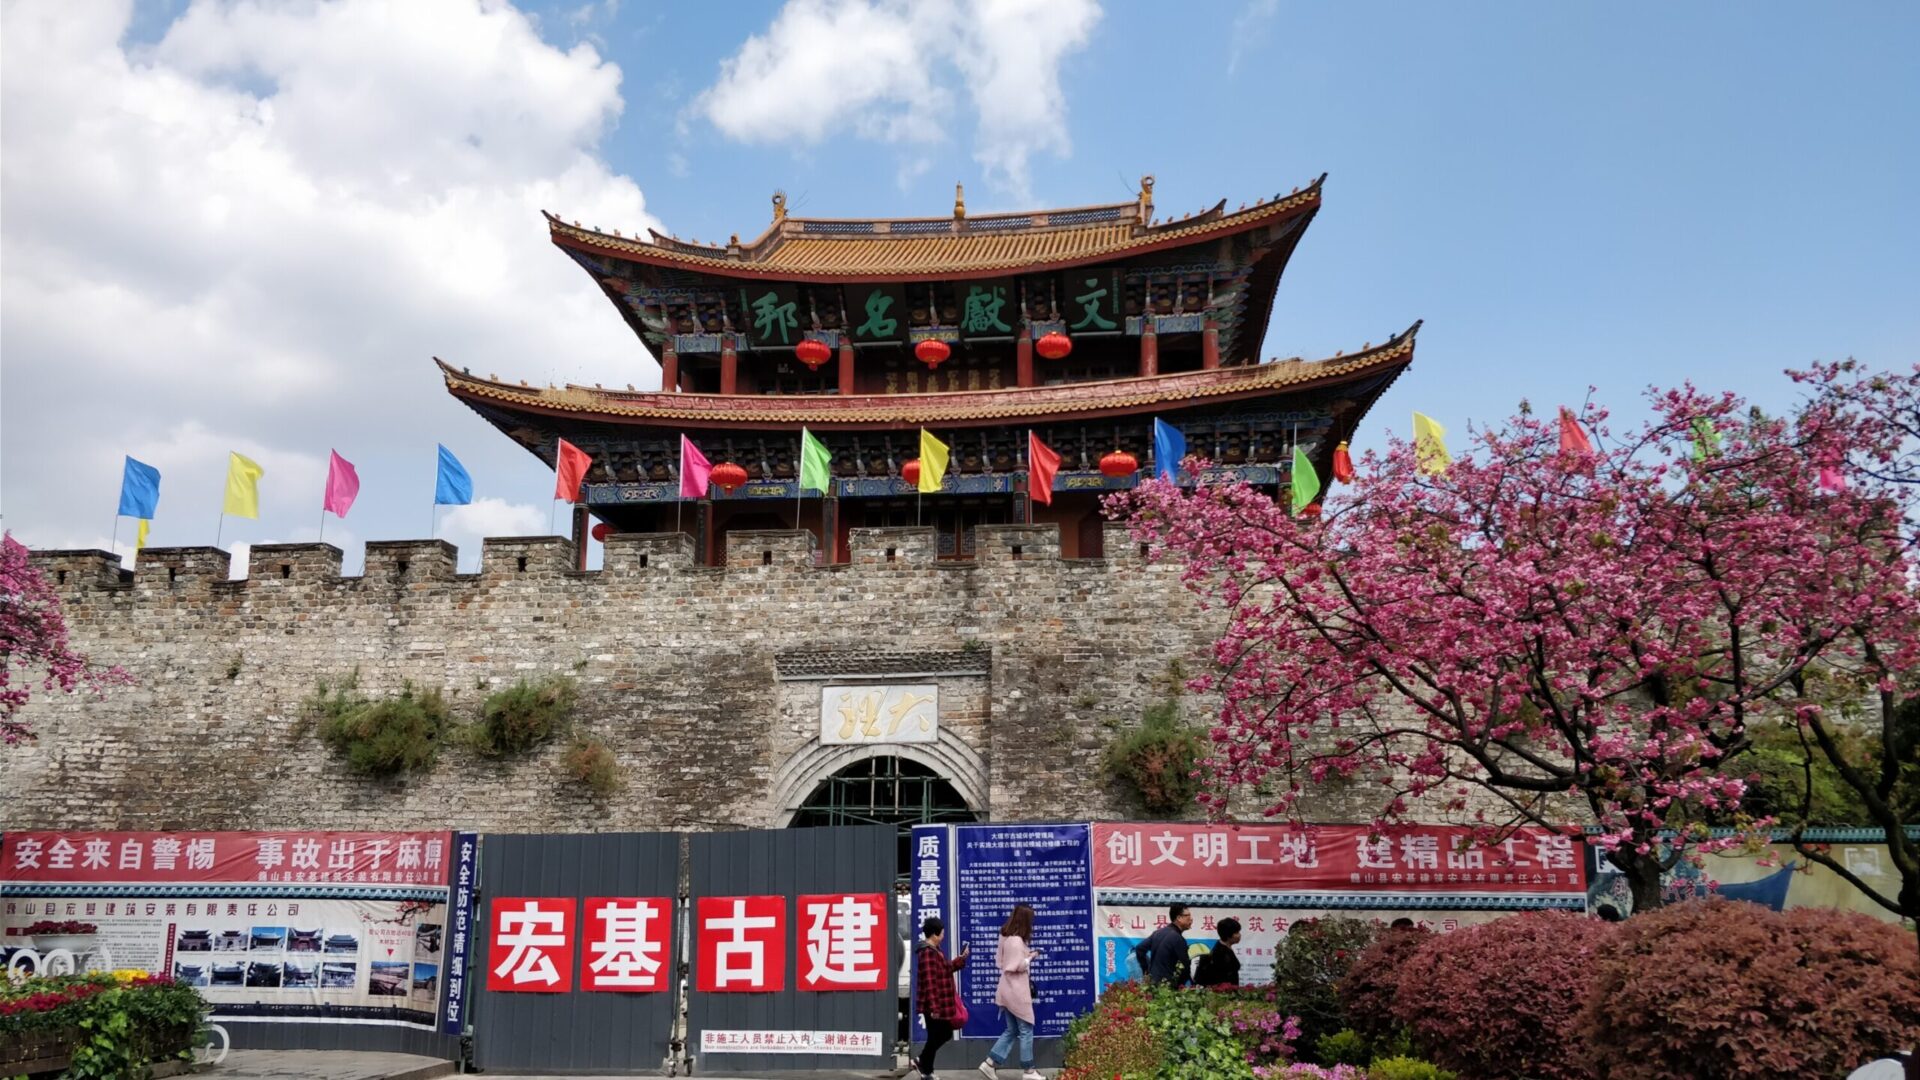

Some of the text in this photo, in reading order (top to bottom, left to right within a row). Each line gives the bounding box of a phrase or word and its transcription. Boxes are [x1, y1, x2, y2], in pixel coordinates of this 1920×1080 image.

[14, 837, 443, 870] 安全来自警惕 事故出于麻痹
[1106, 831, 1577, 870] 创文明工地 建精品工程
[6, 902, 299, 916] 巍山县宏基建筑安装有限责任公司
[446, 841, 472, 1022] 安全防范精细到位
[494, 896, 881, 987] 宏基古建
